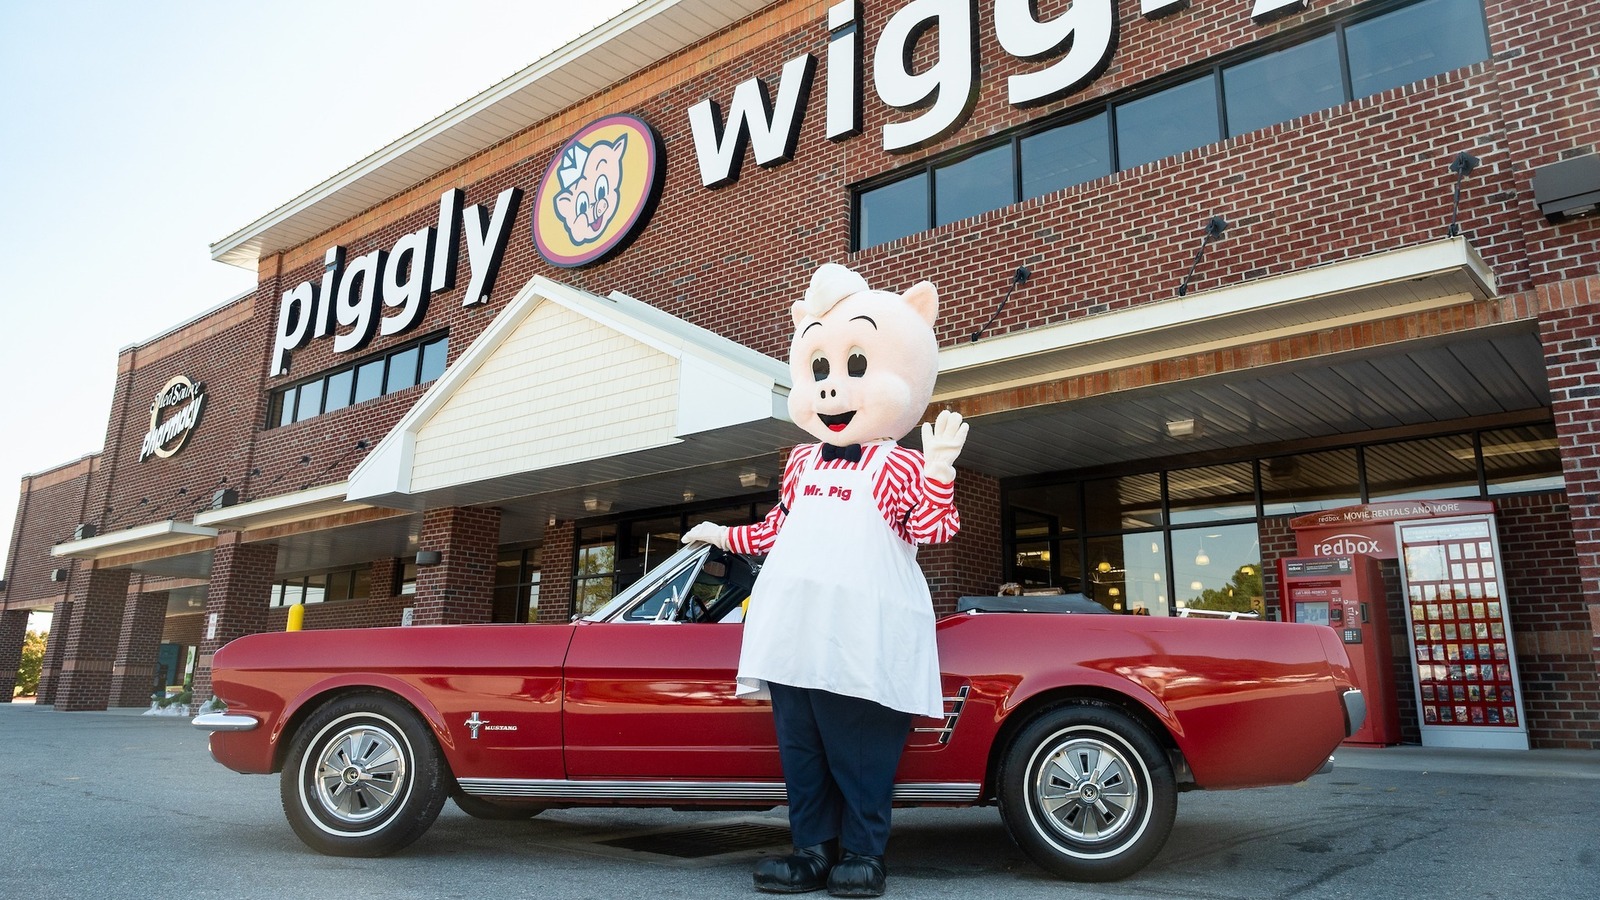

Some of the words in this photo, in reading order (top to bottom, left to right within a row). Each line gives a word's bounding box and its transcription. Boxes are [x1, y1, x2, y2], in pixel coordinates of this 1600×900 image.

[270, 187, 520, 377] piggly
[688, 0, 1309, 189] wigg
[804, 485, 823, 496] Mr.
[828, 485, 852, 501] Pig
[1343, 508, 1370, 521] MOVIE
[1372, 506, 1411, 519] RENTALS
[1412, 504, 1432, 515] AND
[1433, 502, 1460, 513] MORE
[1313, 538, 1382, 557] redbox
